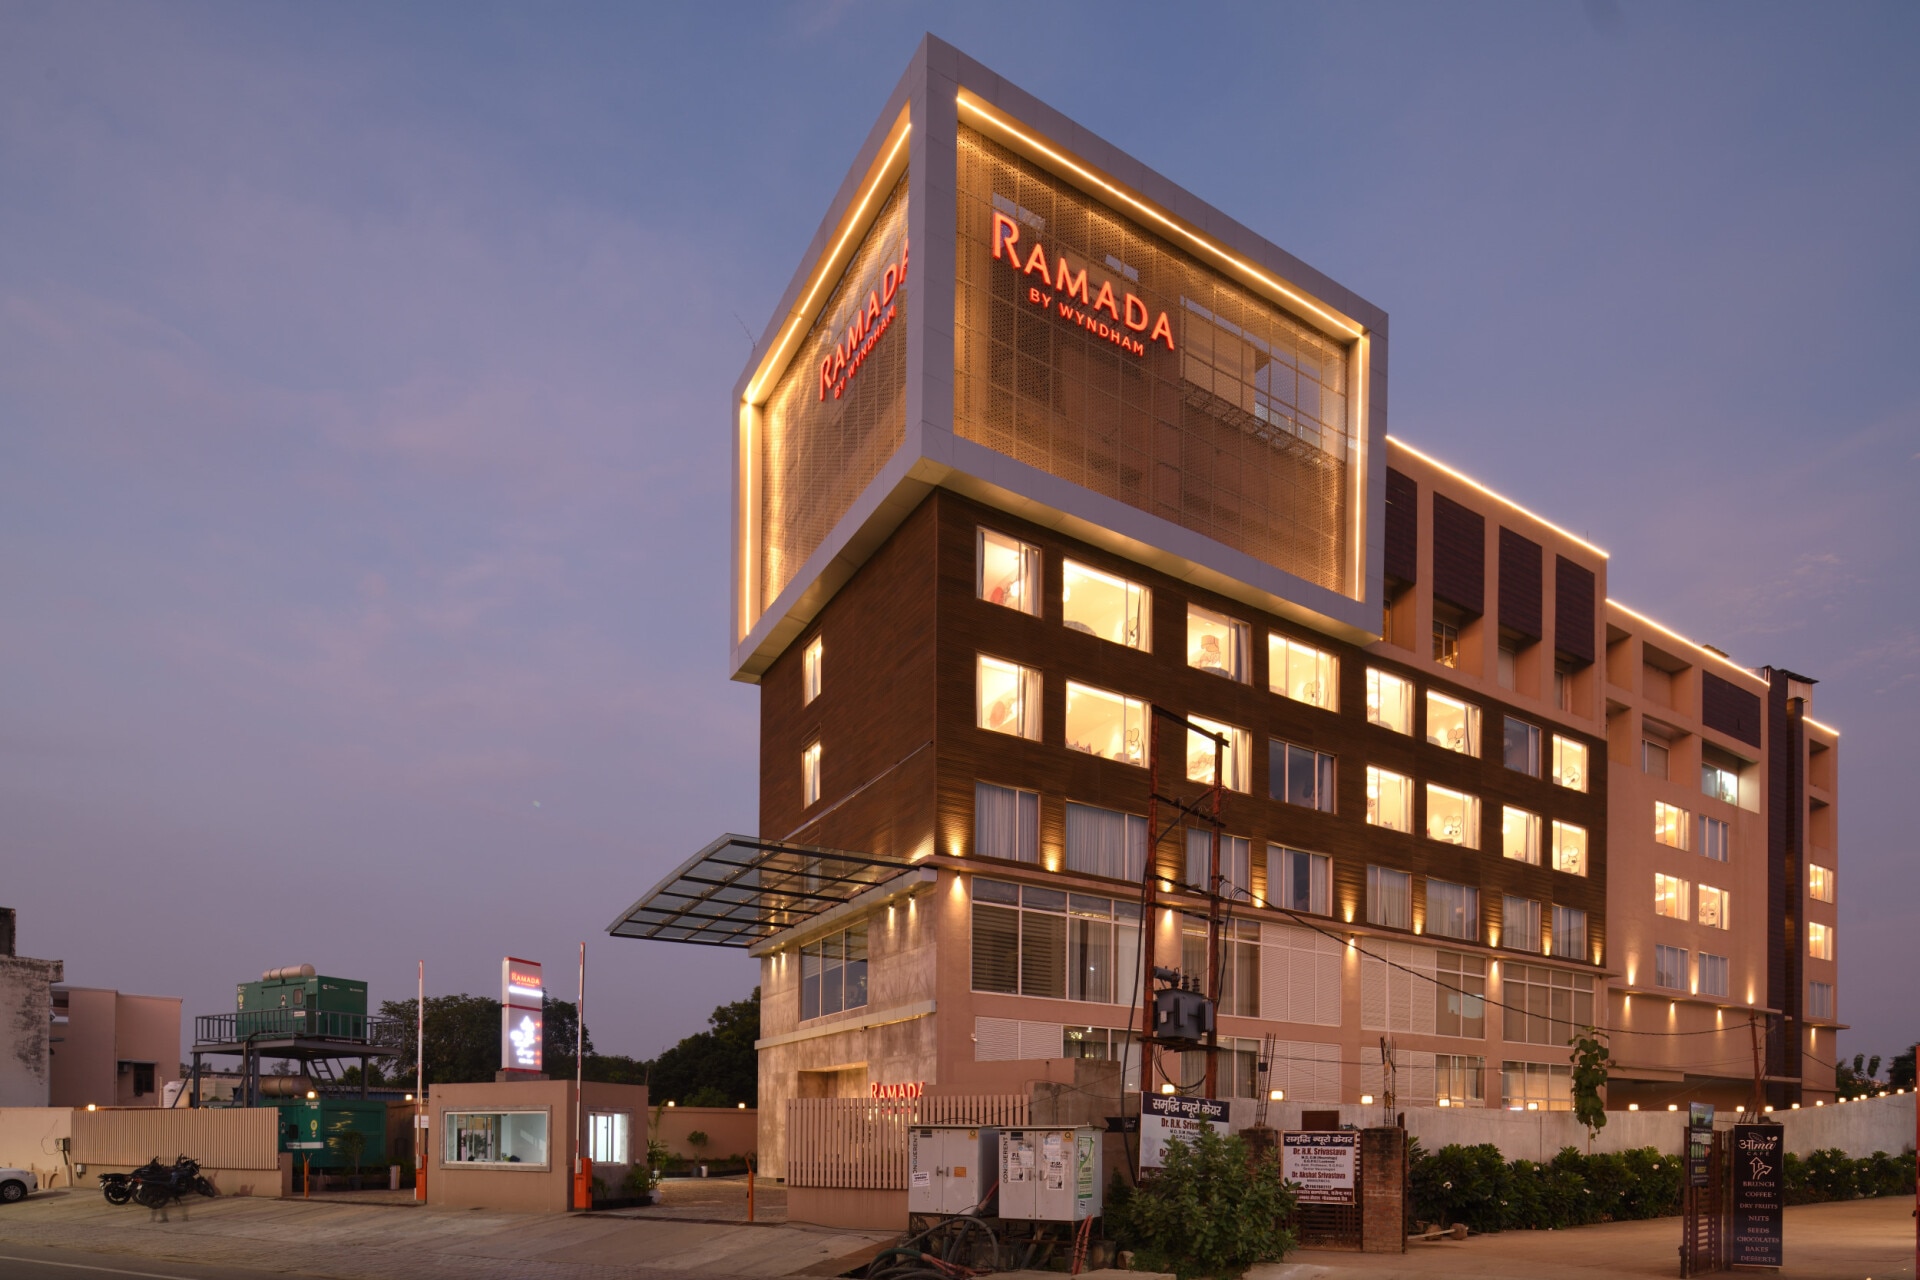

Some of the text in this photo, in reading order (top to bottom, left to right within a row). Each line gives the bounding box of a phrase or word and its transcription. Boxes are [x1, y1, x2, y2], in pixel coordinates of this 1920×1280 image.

[992, 212, 1175, 351] RAMADA
[1029, 287, 1144, 357] BY WYNDHAM
[847, 304, 897, 379] WYNDHAM
[511, 972, 541, 985] RAMADA
[1201, 1101, 1222, 1117] केयर
[1161, 1118, 1170, 1128] Dr.
[1170, 1119, 1182, 1130] R.K.
[1293, 1147, 1347, 1156] Dr. R.K. Srivastava
[1299, 1171, 1317, 1179] Akshat
[1317, 1171, 1346, 1179] Srivastava
[1737, 1236, 1780, 1244] CHOCOLATES
[1745, 1245, 1769, 1253] BAKES
[1740, 1255, 1777, 1263] DESSERTS
